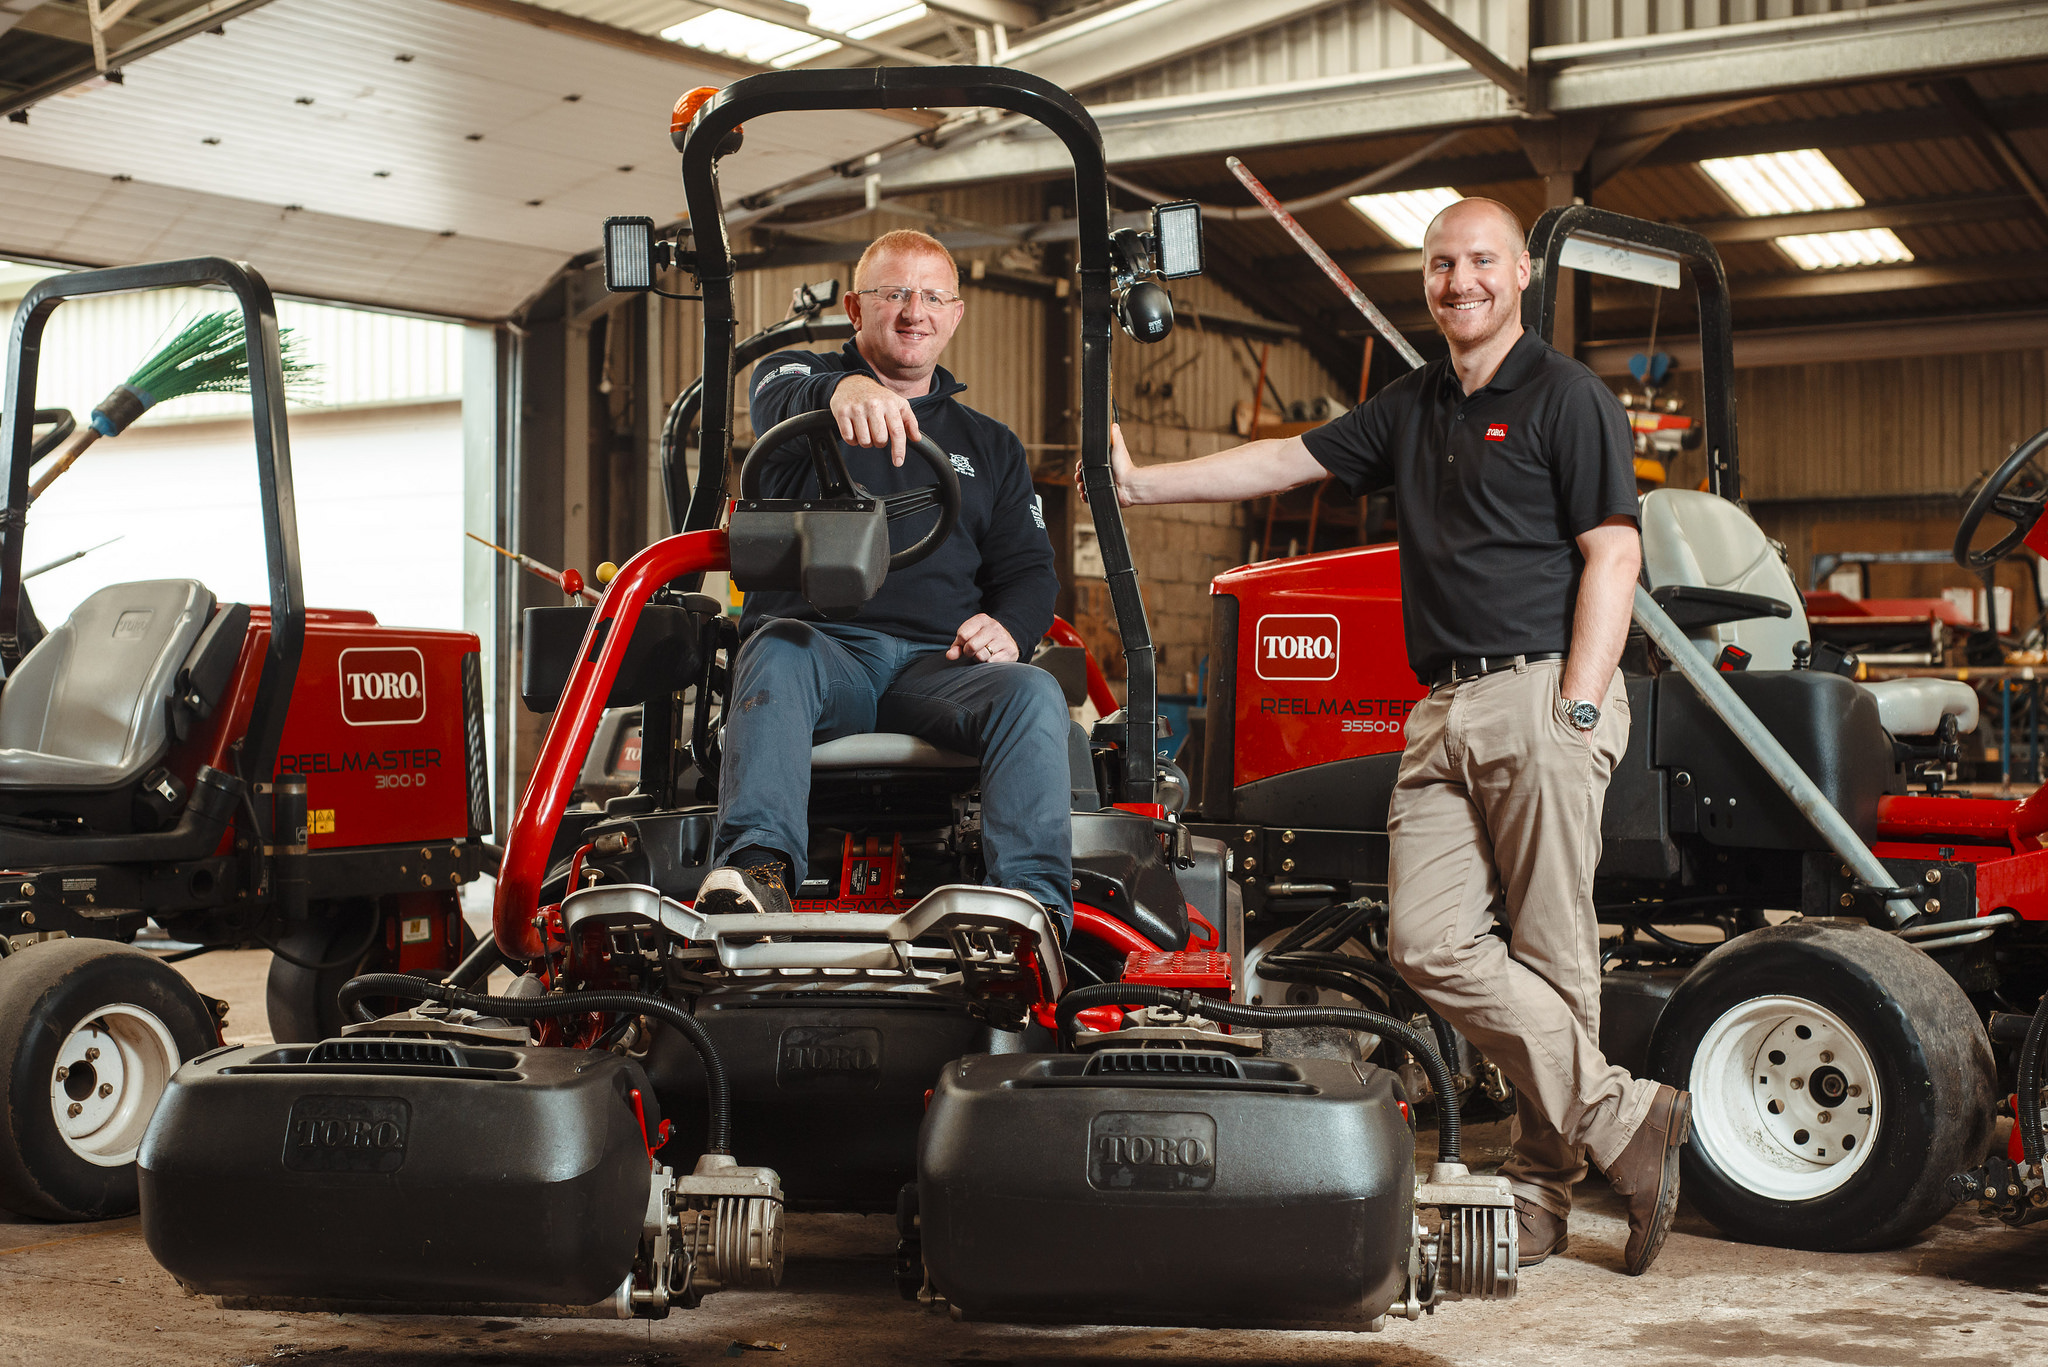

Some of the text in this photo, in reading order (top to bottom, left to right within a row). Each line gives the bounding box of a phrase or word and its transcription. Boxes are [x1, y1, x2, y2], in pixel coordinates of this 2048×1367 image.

[1263, 635, 1333, 660] TORO
[347, 671, 418, 700] TORO
[1260, 698, 1418, 717] REELMASTER
[280, 748, 442, 775] REELMASTER
[624, 746, 641, 762] TO
[298, 1119, 399, 1147] TORO
[1100, 1135, 1206, 1166] TORO
